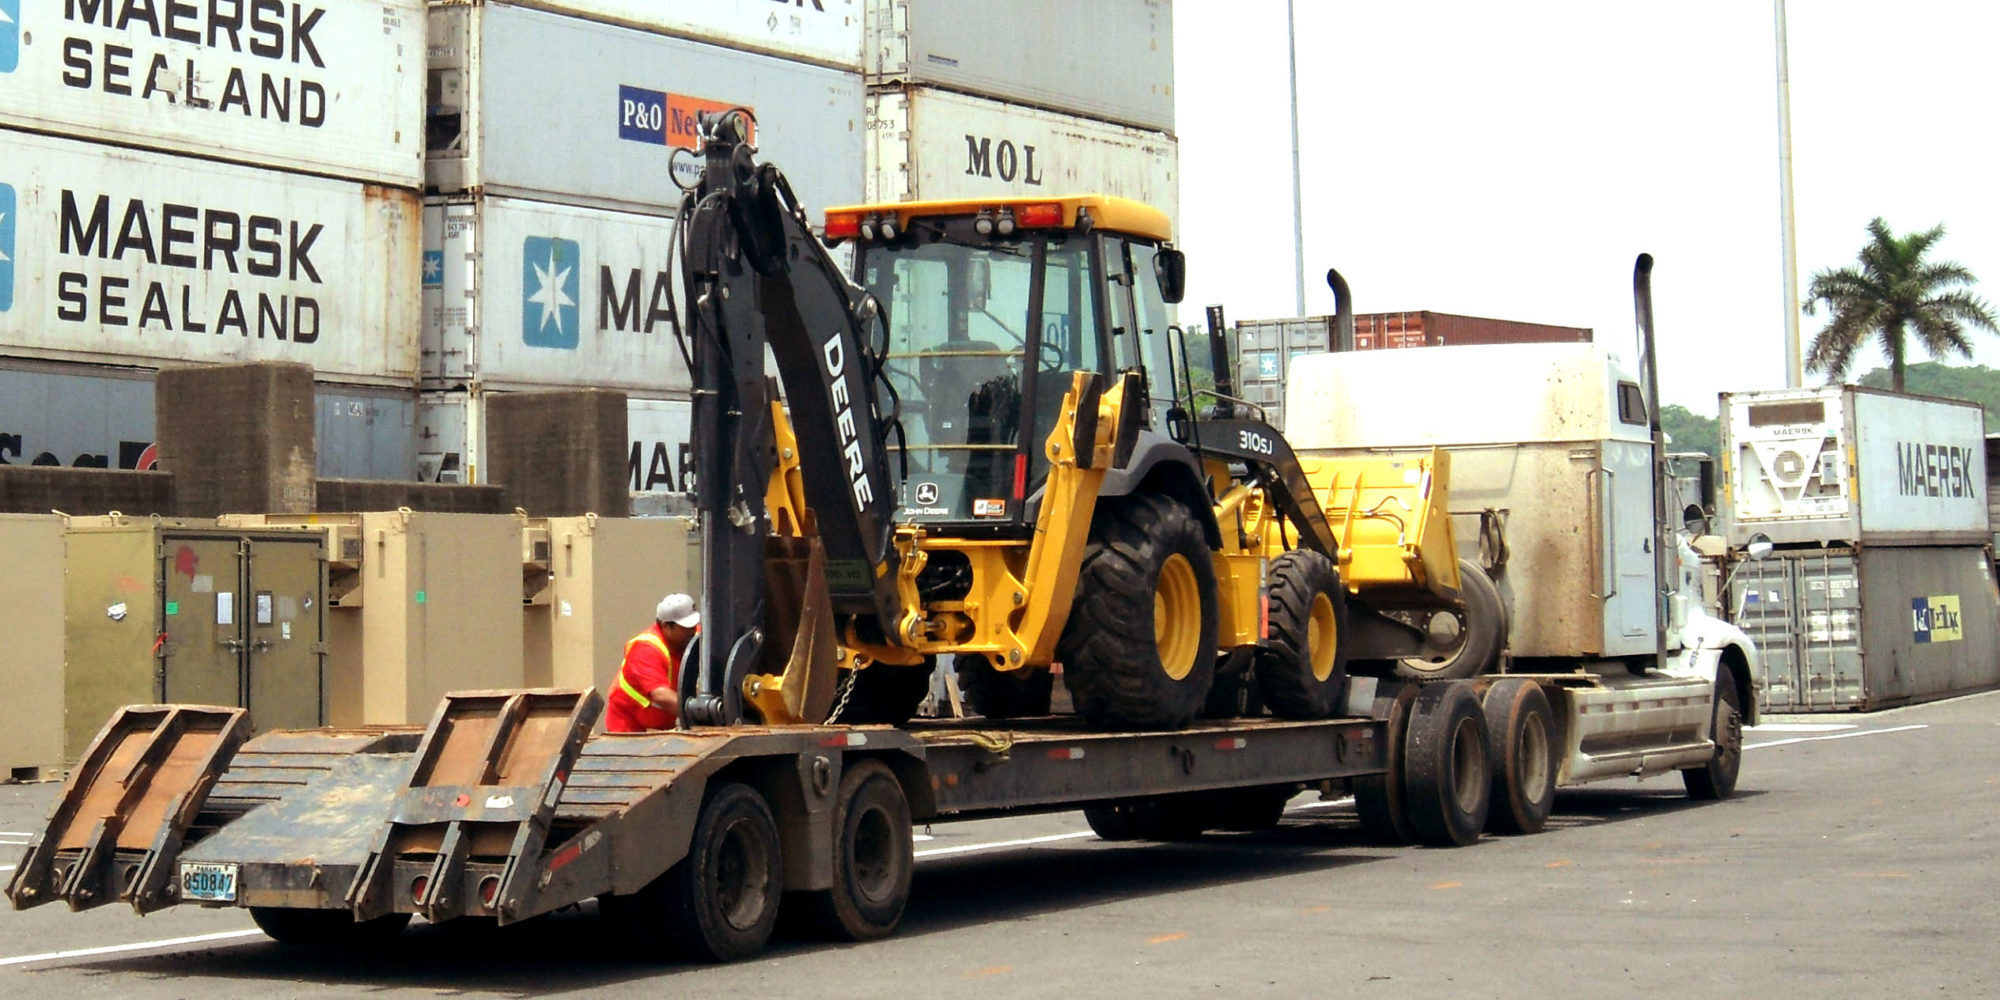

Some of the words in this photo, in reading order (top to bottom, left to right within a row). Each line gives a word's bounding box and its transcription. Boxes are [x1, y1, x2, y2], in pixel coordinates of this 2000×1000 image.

[62, 36, 326, 128] SEALAND
[623, 99, 662, 131] P&O
[965, 134, 1043, 186] MOL
[60, 189, 324, 284] MAERSK
[57, 271, 320, 345] SEALAND
[824, 332, 874, 513] DEERE
[1239, 430, 1273, 455] 310SJ
[1897, 441, 1975, 499] MAERSK
[903, 507, 923, 515] JOHN
[923, 507, 949, 515] DEERE
[184, 872, 233, 892] 850847
